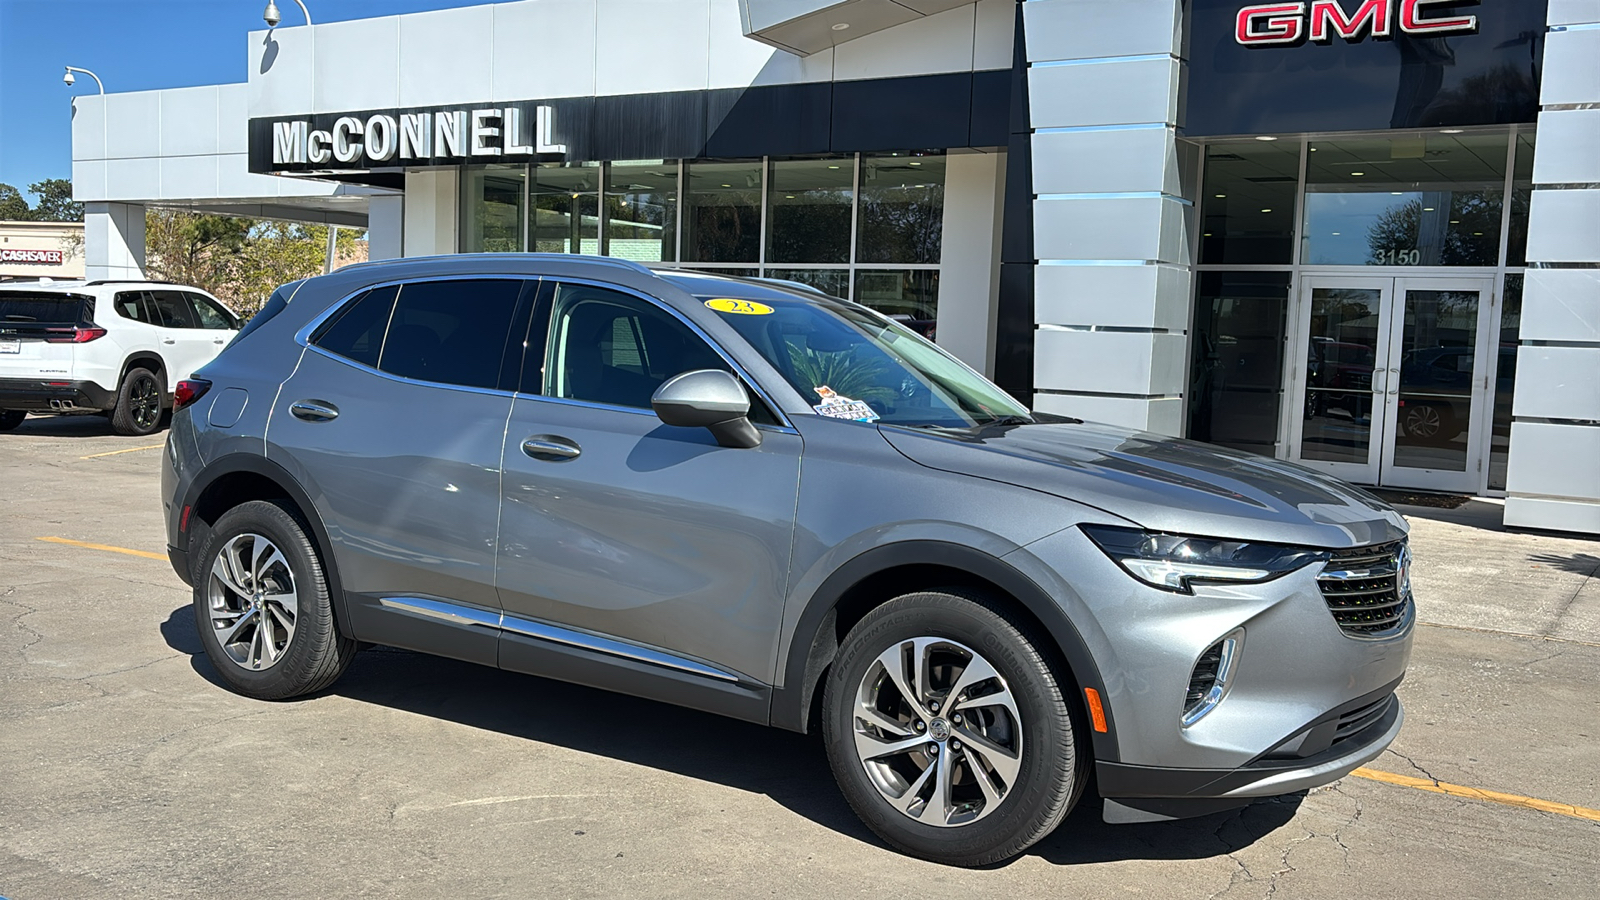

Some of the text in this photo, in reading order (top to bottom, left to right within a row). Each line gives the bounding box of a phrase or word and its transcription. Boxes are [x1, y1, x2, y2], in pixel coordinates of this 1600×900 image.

[1235, 0, 1478, 45] GMC
[272, 105, 566, 164] McCONNELL
[2, 250, 61, 262] CASHSAVER
[1376, 249, 1421, 266] 3150
[726, 300, 755, 313] 23
